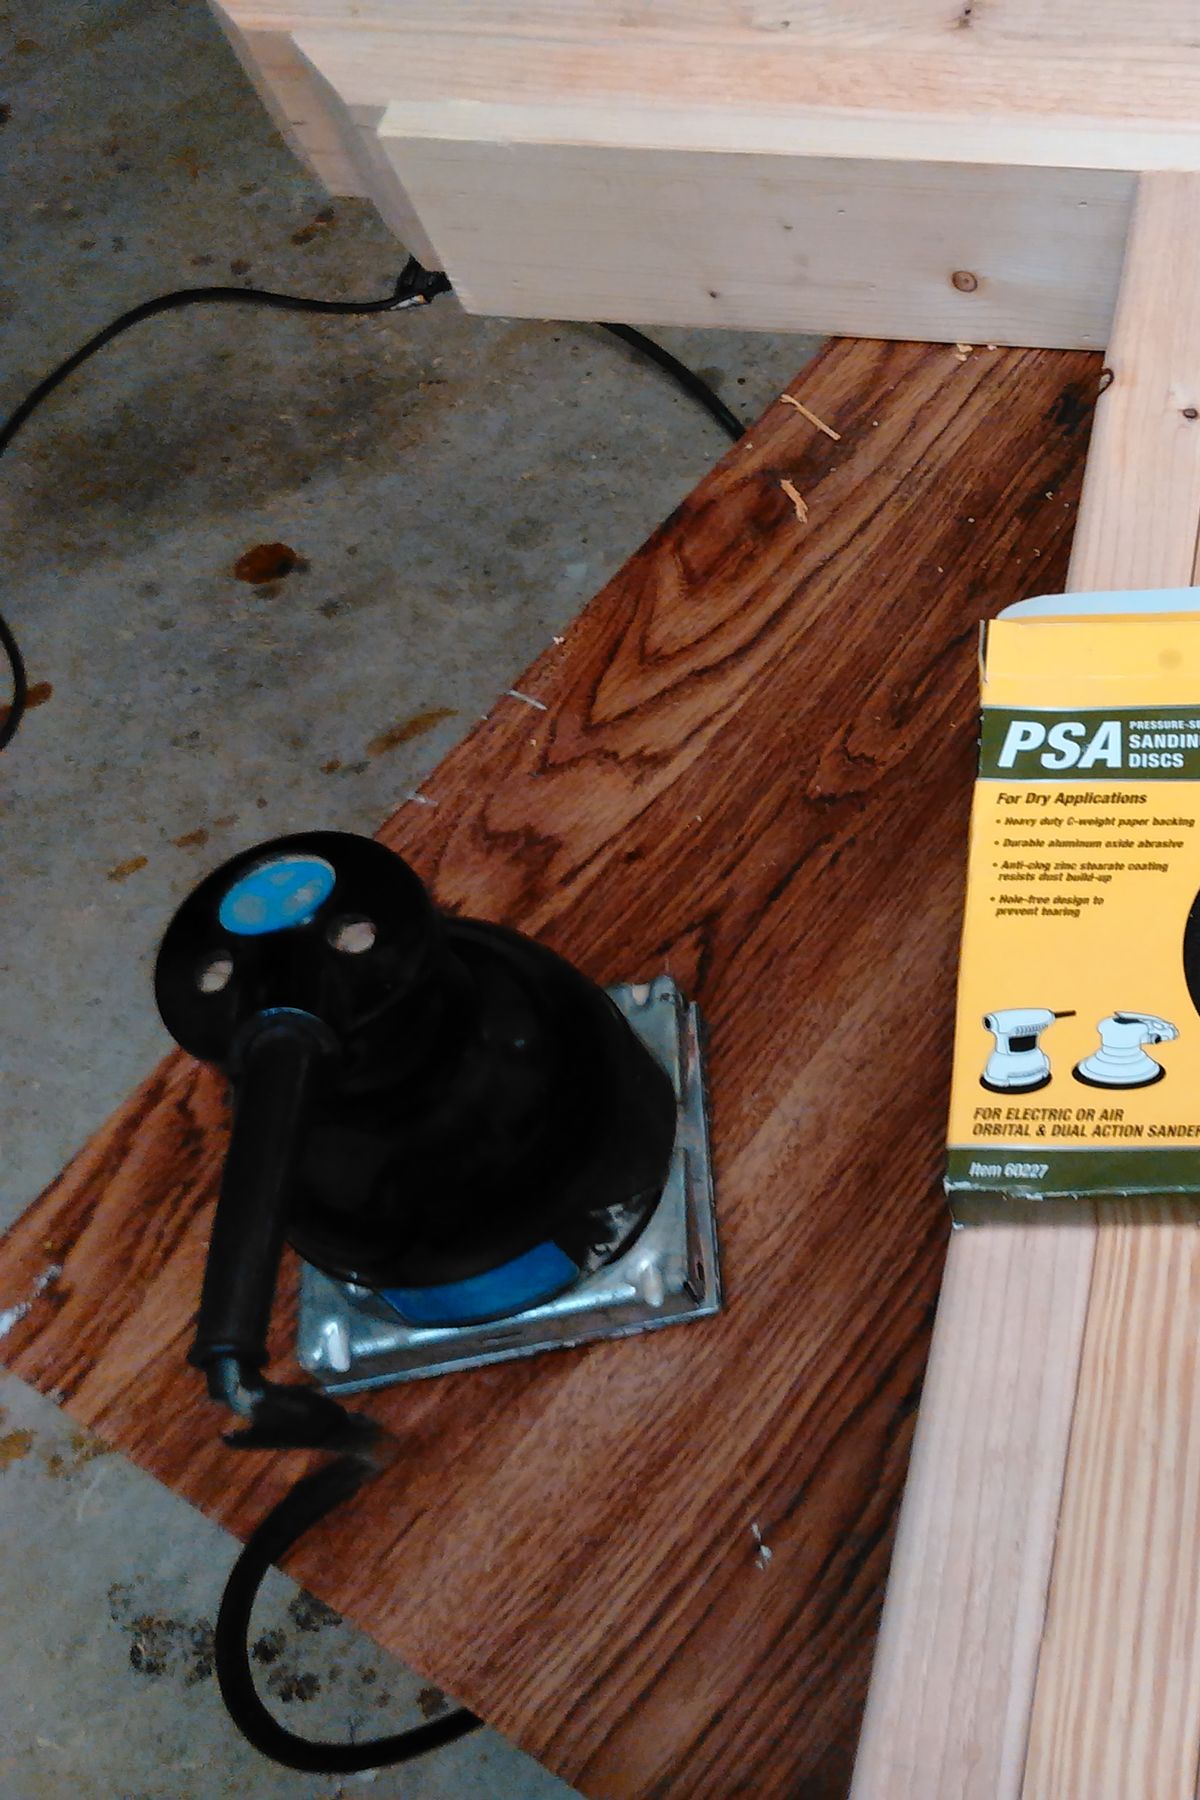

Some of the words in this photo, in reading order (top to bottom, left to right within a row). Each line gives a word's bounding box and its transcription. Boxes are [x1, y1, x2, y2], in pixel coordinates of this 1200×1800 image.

[998, 720, 1122, 770] PSA
[1128, 753, 1184, 768] DISCS
[997, 793, 1021, 805] For
[1026, 793, 1051, 806] Dry
[1054, 792, 1147, 806] Applications
[1004, 817, 1037, 827] Heavy
[1039, 817, 1064, 827] duty
[1118, 818, 1148, 828] paper
[1152, 817, 1195, 828] backing
[1003, 839, 1045, 848] Durable
[1048, 838, 1102, 848] aluminum
[1105, 839, 1134, 848] oxide
[1137, 839, 1184, 848] abrasive
[1127, 862, 1168, 872] coating
[998, 872, 1035, 881] resists
[1038, 873, 1063, 881] dust
[1052, 896, 1089, 906] design
[1093, 896, 1104, 905] to
[995, 907, 1038, 918] prevent
[1041, 907, 1080, 918] tearing
[973, 1107, 1002, 1121] FOR
[1005, 1107, 1073, 1121] ELECTRIC
[1076, 1108, 1096, 1121] OR
[1099, 1109, 1125, 1121] AIR
[972, 1123, 1031, 1137] ORBITAL
[1035, 1123, 1046, 1137] &
[1051, 1123, 1087, 1137] DUAL
[1091, 1124, 1143, 1138] ACTION
[968, 1161, 1002, 1178] Item
